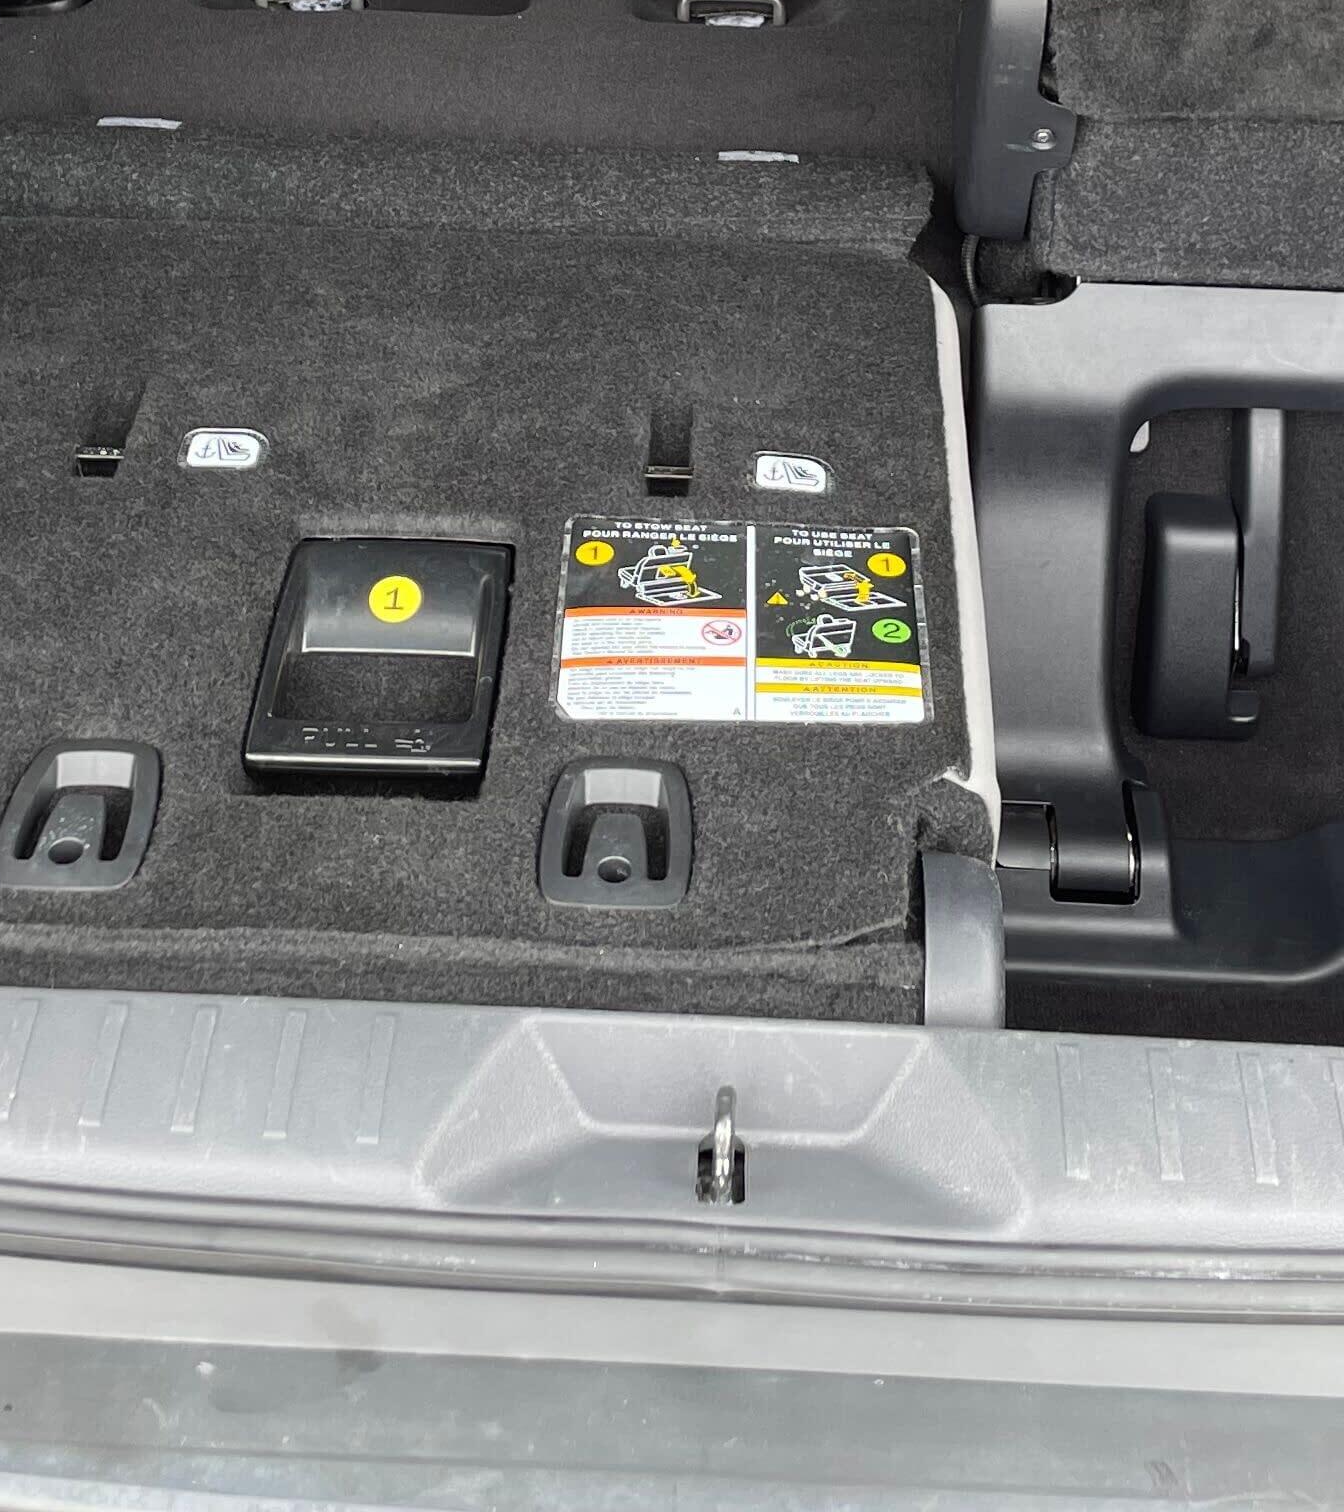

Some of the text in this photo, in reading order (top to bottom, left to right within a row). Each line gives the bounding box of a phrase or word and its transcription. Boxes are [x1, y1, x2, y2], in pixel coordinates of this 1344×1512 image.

[614, 521, 632, 529] TO
[674, 524, 708, 532] SEAT
[583, 530, 620, 538] POUR
[622, 531, 676, 540] RANGER
[680, 533, 696, 541] LE
[792, 529, 873, 541] TO USE SEAT
[774, 536, 890, 550] POUR UTILISER LE
[384, 587, 404, 610] 1
[883, 624, 900, 639] 2
